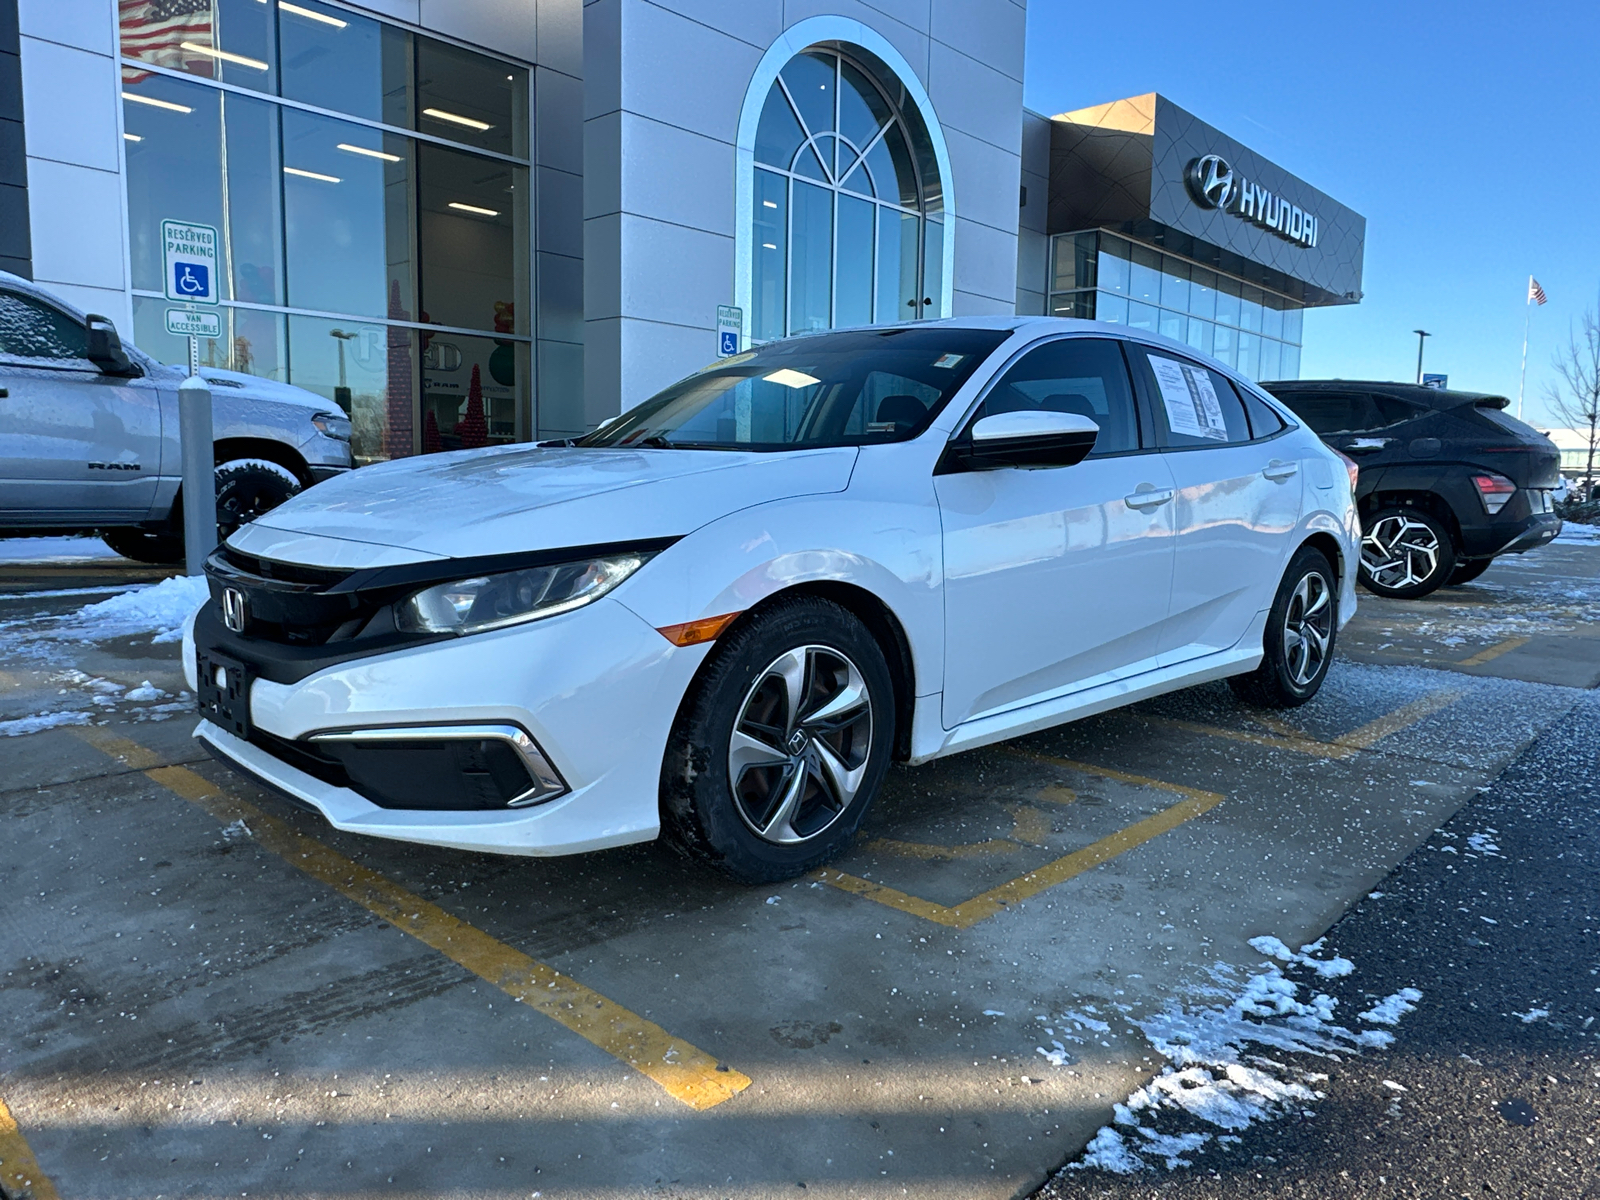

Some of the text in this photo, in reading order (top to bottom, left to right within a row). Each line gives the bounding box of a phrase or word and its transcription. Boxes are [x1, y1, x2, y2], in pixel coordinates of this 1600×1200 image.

[1240, 177, 1318, 248] HYUNDAI
[167, 227, 213, 245] RESERVED
[167, 241, 214, 258] PARKING
[185, 313, 202, 323] VAN
[719, 318, 740, 329] PARKING
[170, 322, 217, 333] ACCESSIBLE
[88, 462, 141, 471] RAM
